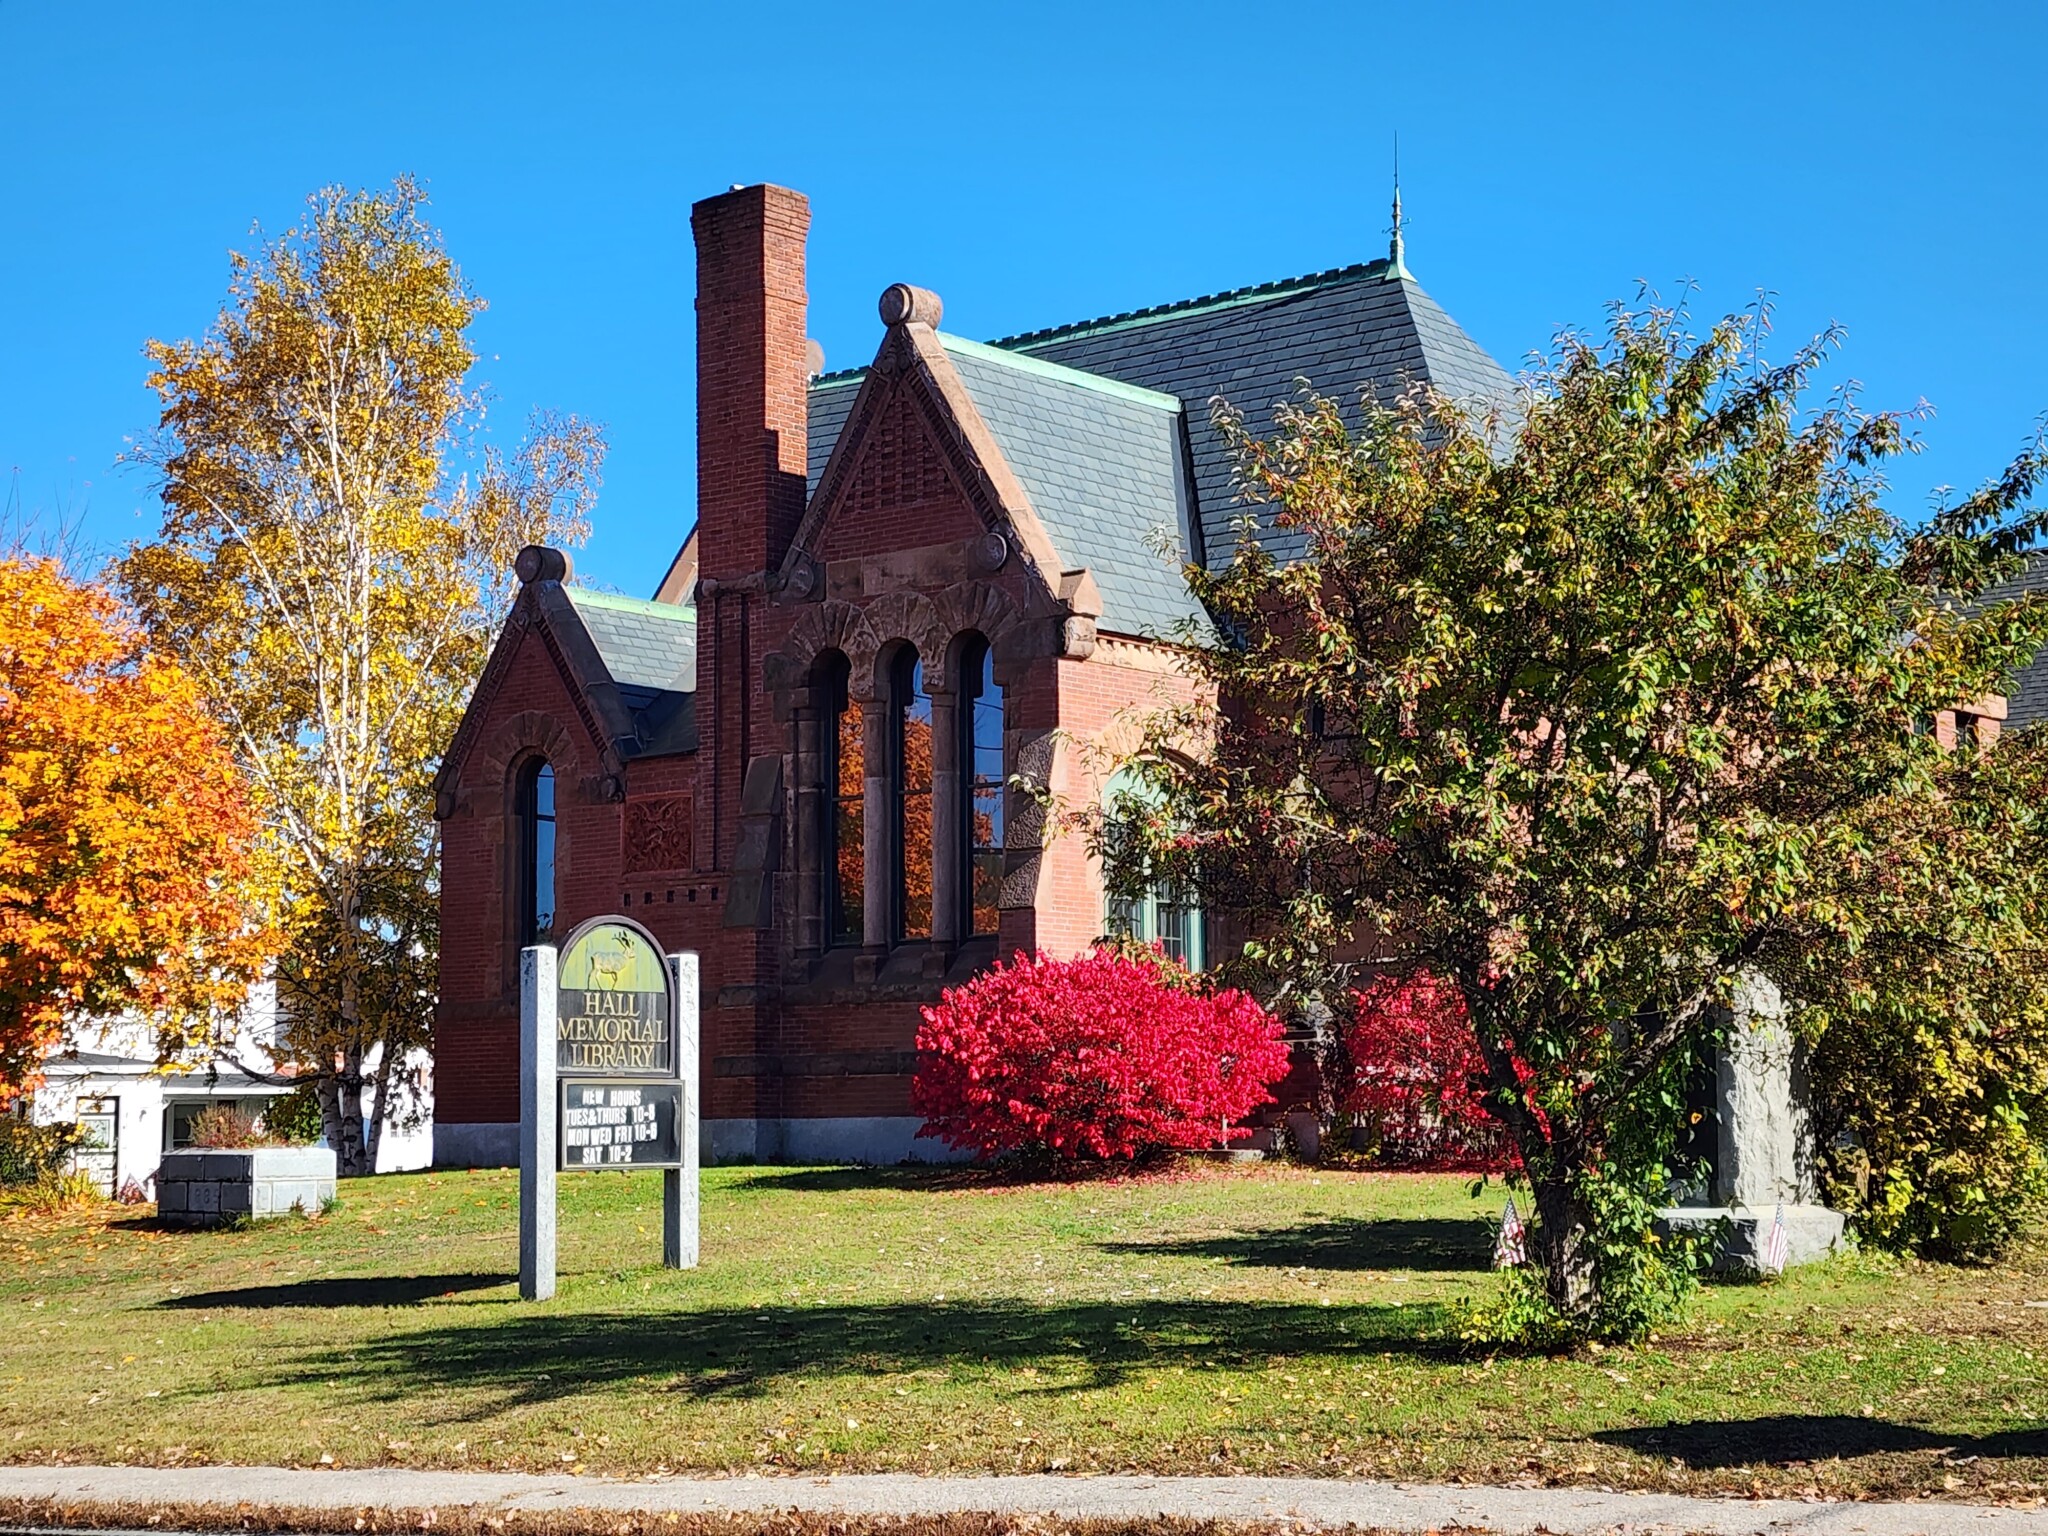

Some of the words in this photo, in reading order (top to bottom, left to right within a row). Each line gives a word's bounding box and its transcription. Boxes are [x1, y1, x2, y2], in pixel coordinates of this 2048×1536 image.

[584, 992, 640, 1017] HALL
[557, 1017, 668, 1043] MEMORIAL
[570, 1043, 655, 1068] LIBRARY
[582, 1088, 605, 1105] NEW
[610, 1090, 641, 1107] HOURS
[567, 1128, 590, 1147] MON
[590, 1127, 612, 1146] WED
[614, 1125, 633, 1144] FRI
[582, 1146, 603, 1165] SAT
[608, 1145, 633, 1164] 10-2
